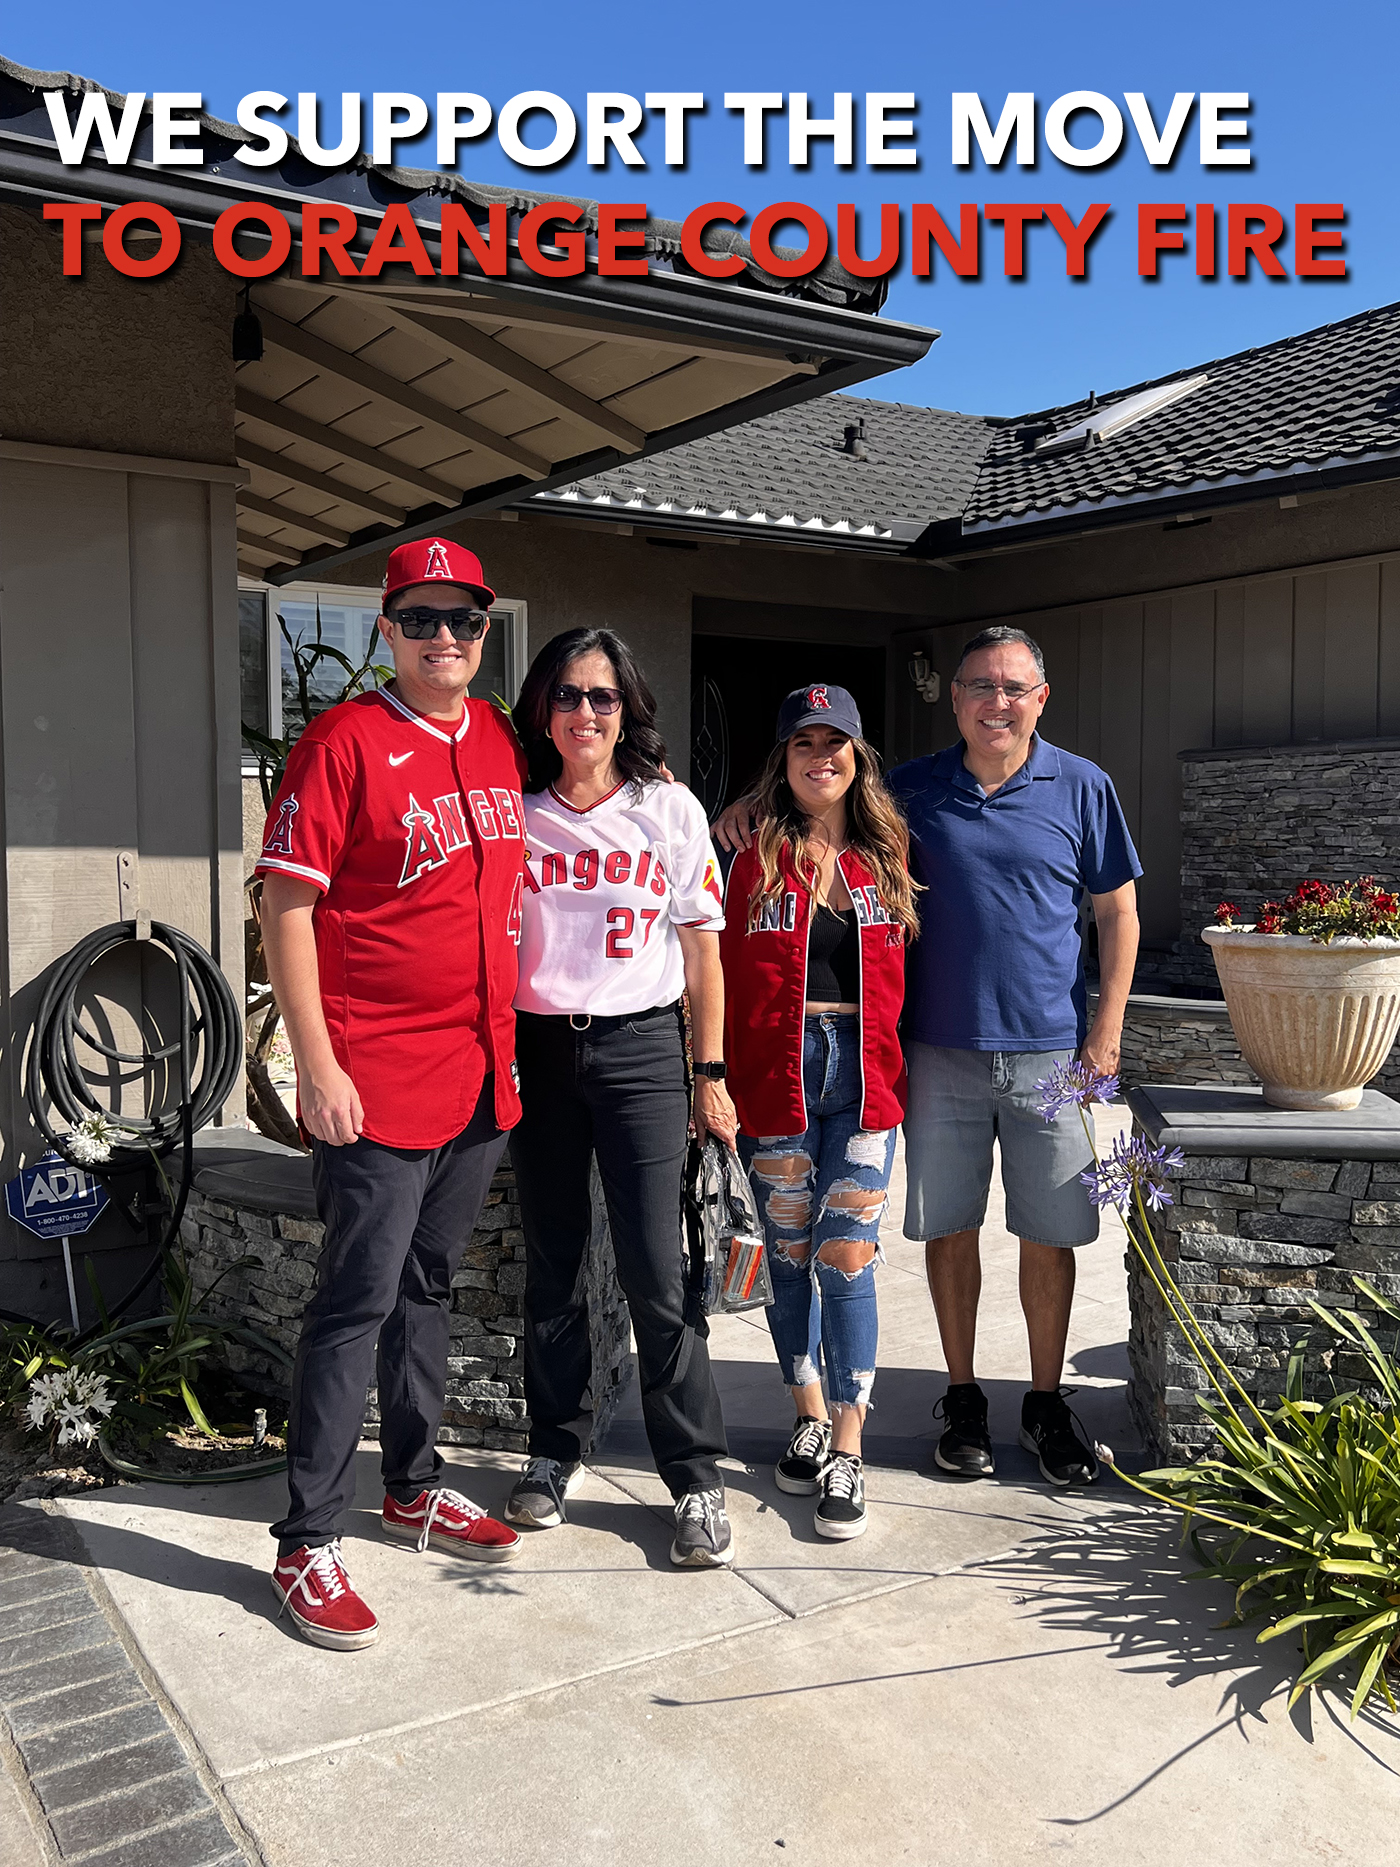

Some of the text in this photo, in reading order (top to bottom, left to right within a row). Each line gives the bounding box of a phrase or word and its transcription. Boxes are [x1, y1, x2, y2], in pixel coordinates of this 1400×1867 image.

[424, 541, 453, 579] A
[263, 792, 299, 854] A
[605, 907, 661, 959] 27
[26, 1166, 88, 1208] ADT
